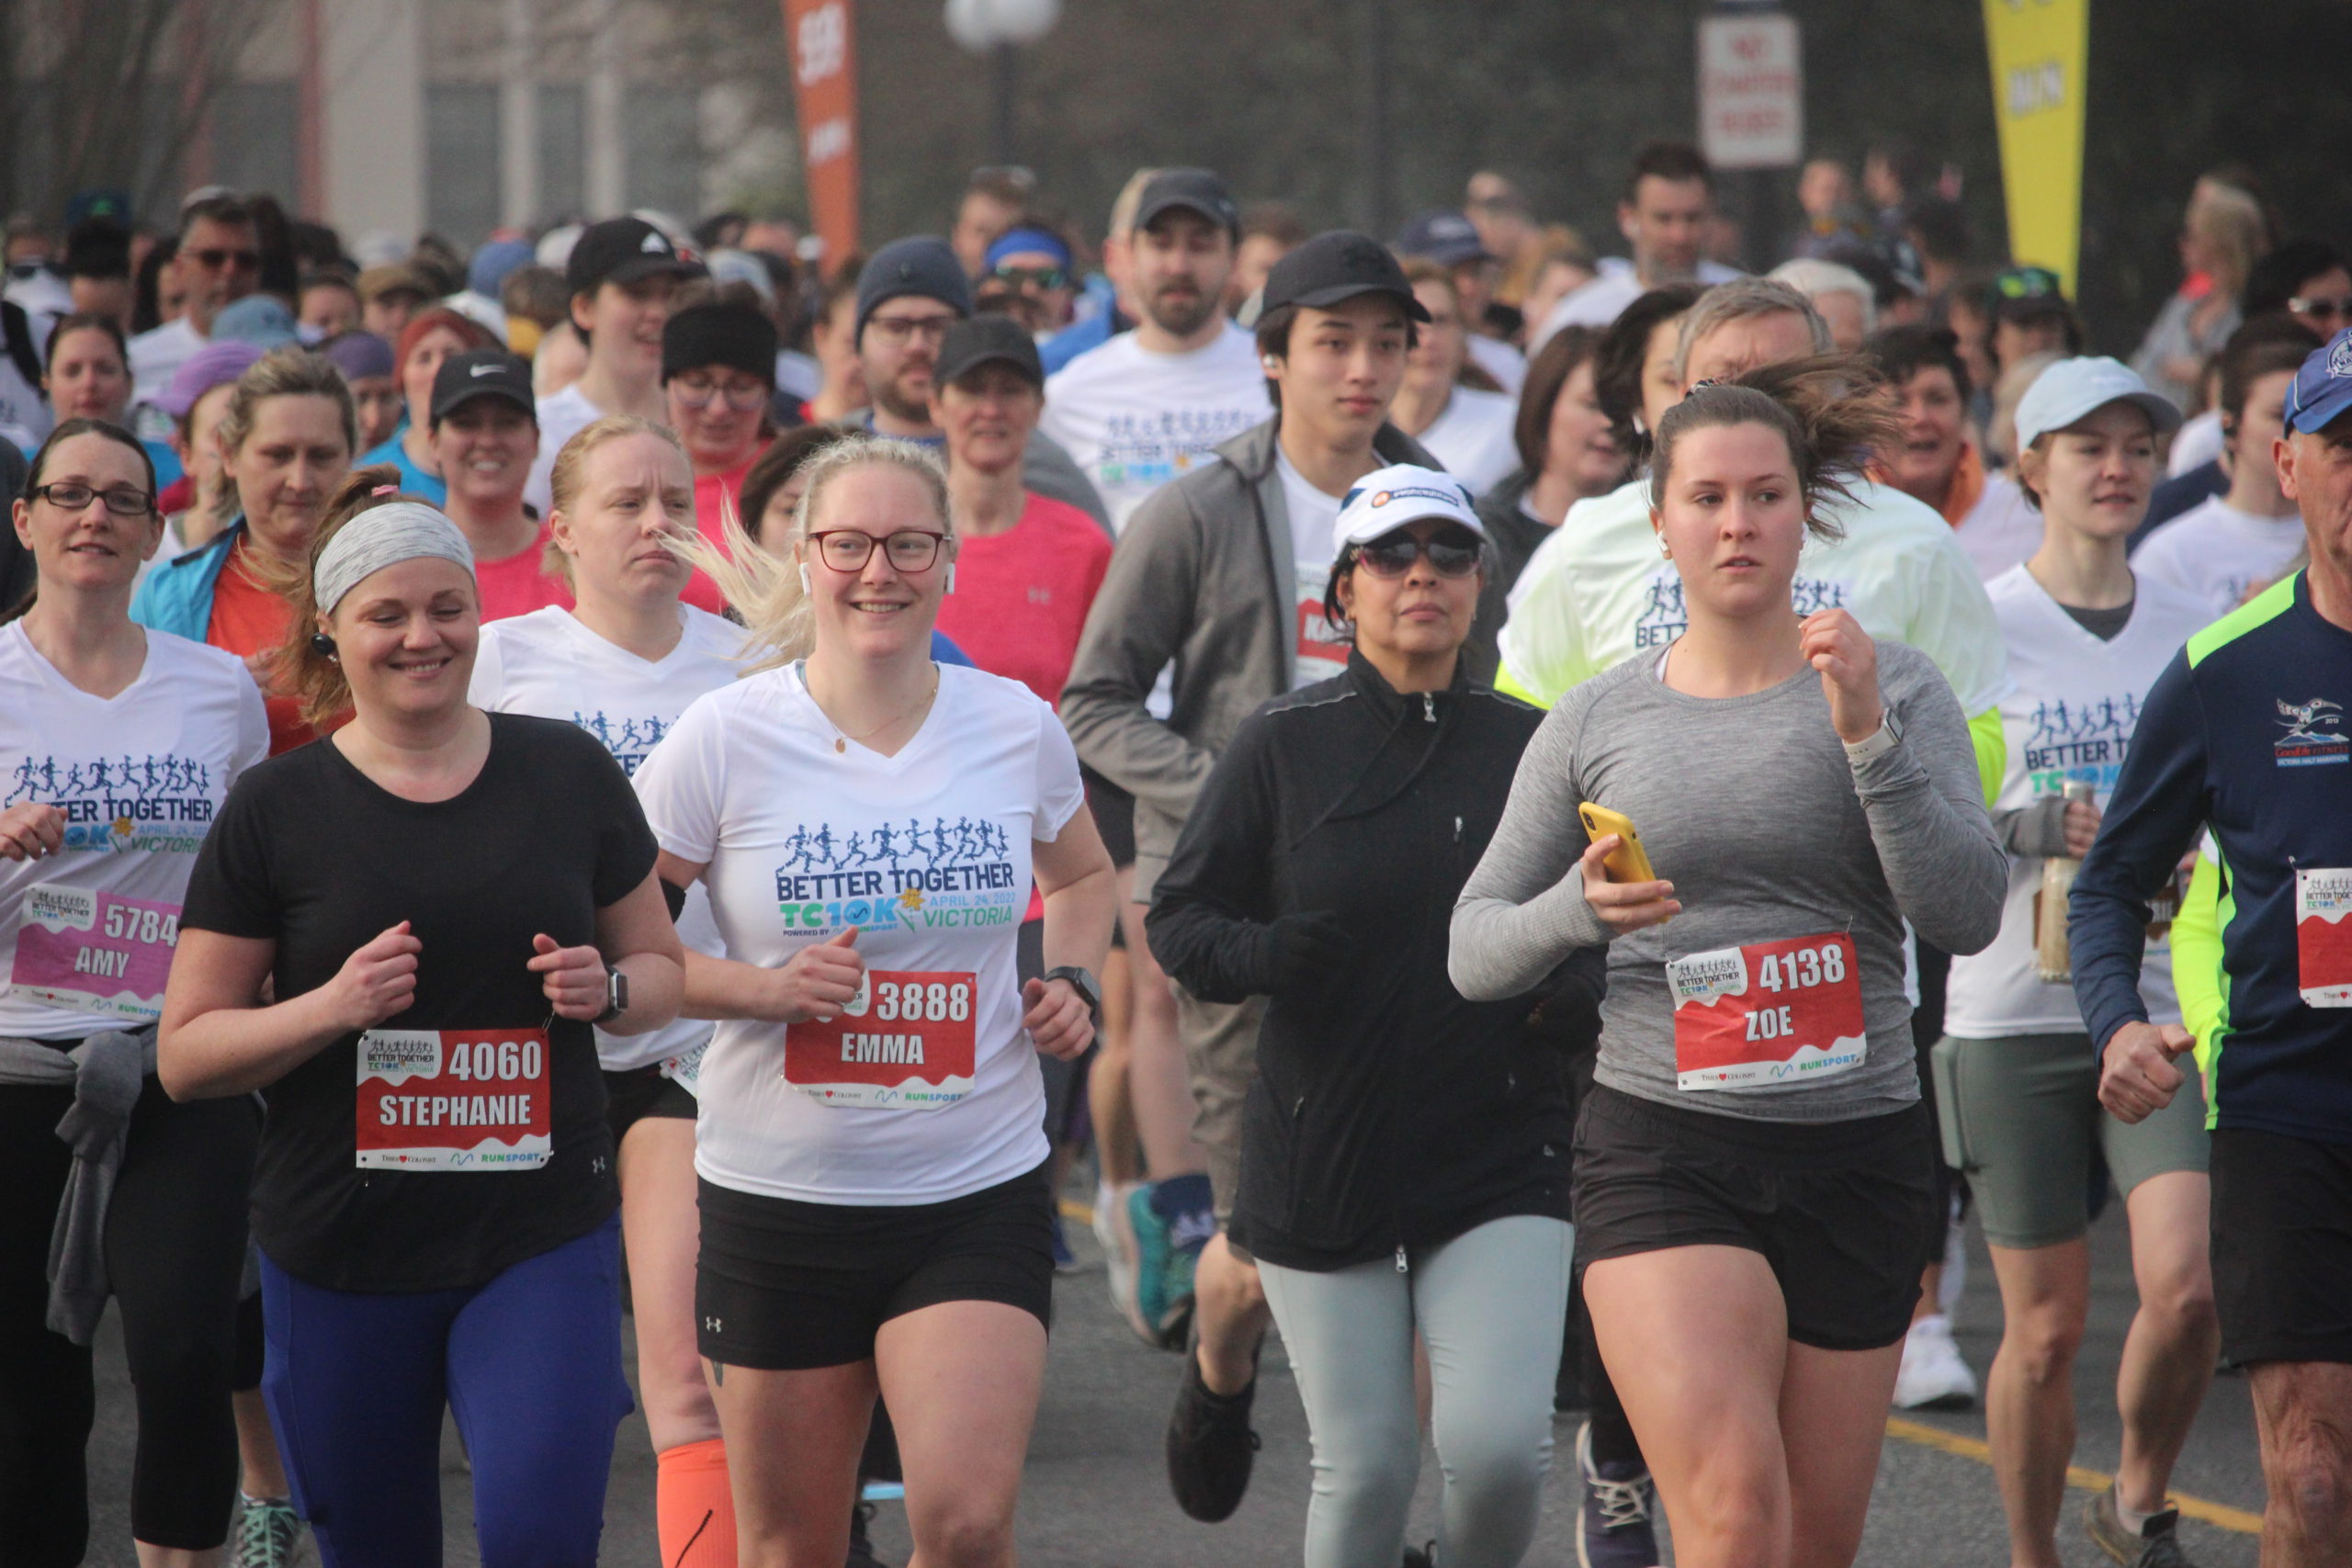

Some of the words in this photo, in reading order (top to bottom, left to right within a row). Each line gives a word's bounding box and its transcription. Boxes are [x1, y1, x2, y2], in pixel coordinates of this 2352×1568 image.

[1636, 623, 1689, 649] BETT
[2026, 740, 2109, 770] BETTER
[104, 797, 212, 822] TOGETHER
[776, 870, 883, 902] BETTER
[888, 863, 1014, 893] TOGETHER
[779, 897, 900, 928] TC10K
[930, 895, 970, 907] APRIL
[993, 890, 1015, 905] 2022
[105, 904, 177, 947] 5784
[922, 906, 1012, 927] VICTORIA
[784, 929, 818, 937] POWERED
[819, 928, 830, 936] BY
[74, 946, 130, 978] AMY
[1759, 944, 1845, 992] 4138
[1678, 976, 1703, 987] BETTER
[1704, 972, 1739, 982] TOGETHER
[876, 982, 969, 1021] 3888
[1745, 1005, 1794, 1042] ZOE
[368, 1054, 396, 1062] BETTER
[398, 1055, 435, 1063] TOGETHER
[448, 1041, 541, 1081] 4060
[841, 1032, 924, 1065] EMMA
[1800, 1054, 1857, 1071] RUNSPORT
[379, 1094, 531, 1126] STEPHANIE
[905, 1092, 963, 1102] RUNSPORT
[481, 1154, 540, 1163] RUNSPORT
